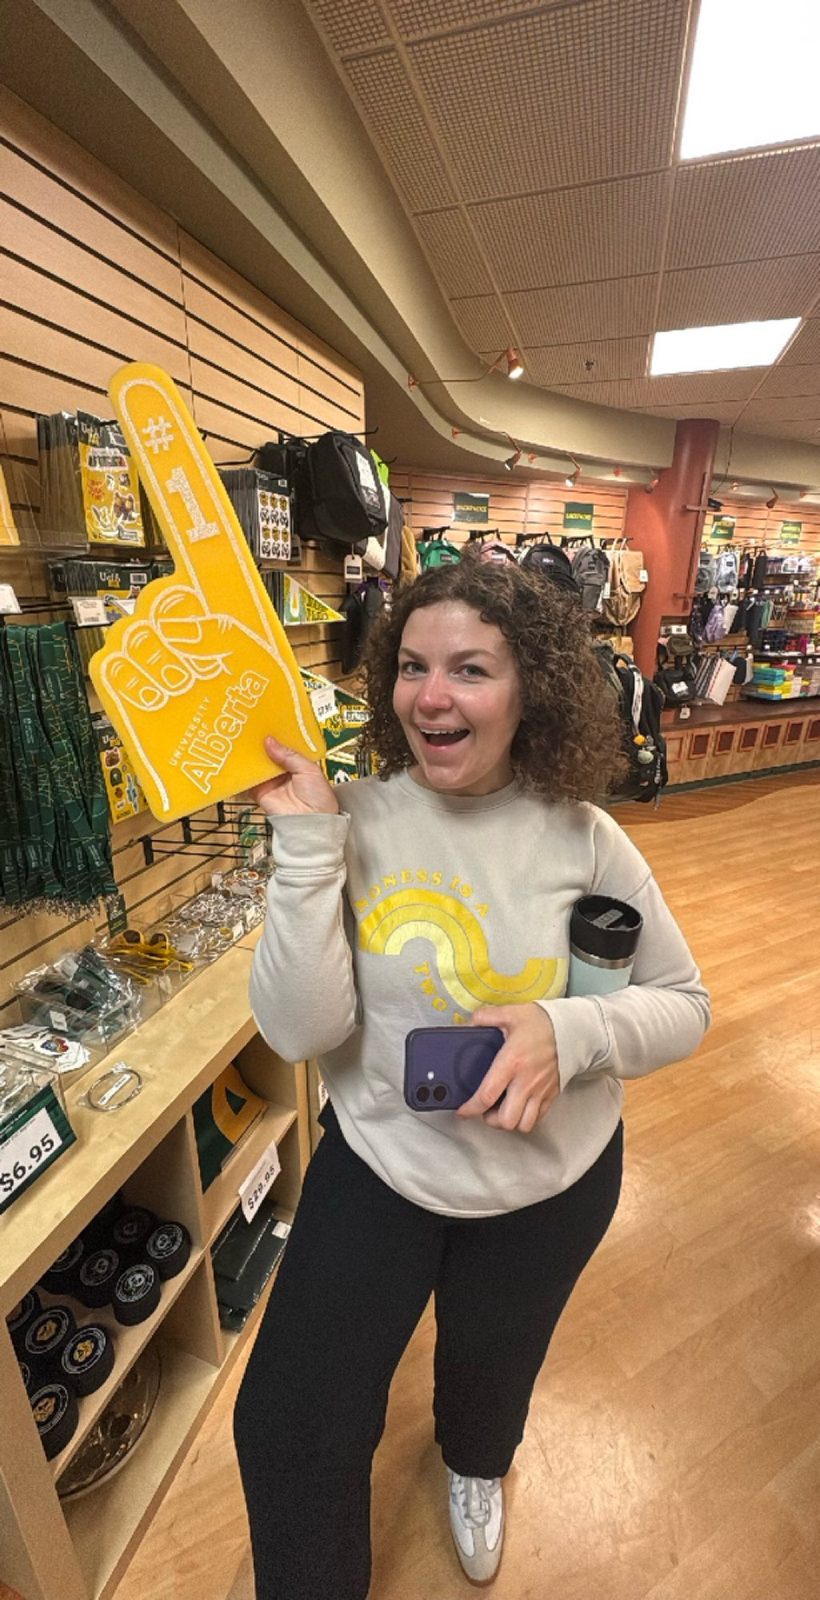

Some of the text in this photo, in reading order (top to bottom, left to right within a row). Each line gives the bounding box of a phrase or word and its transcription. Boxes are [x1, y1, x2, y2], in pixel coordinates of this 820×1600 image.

[165, 466, 220, 543] 1
[169, 696, 210, 766] UNIVERSITY
[180, 670, 267, 795] Alberta
[198, 721, 209, 738] OF
[0, 1133, 55, 1193] $6.95
[247, 1165, 275, 1210] $29.95
